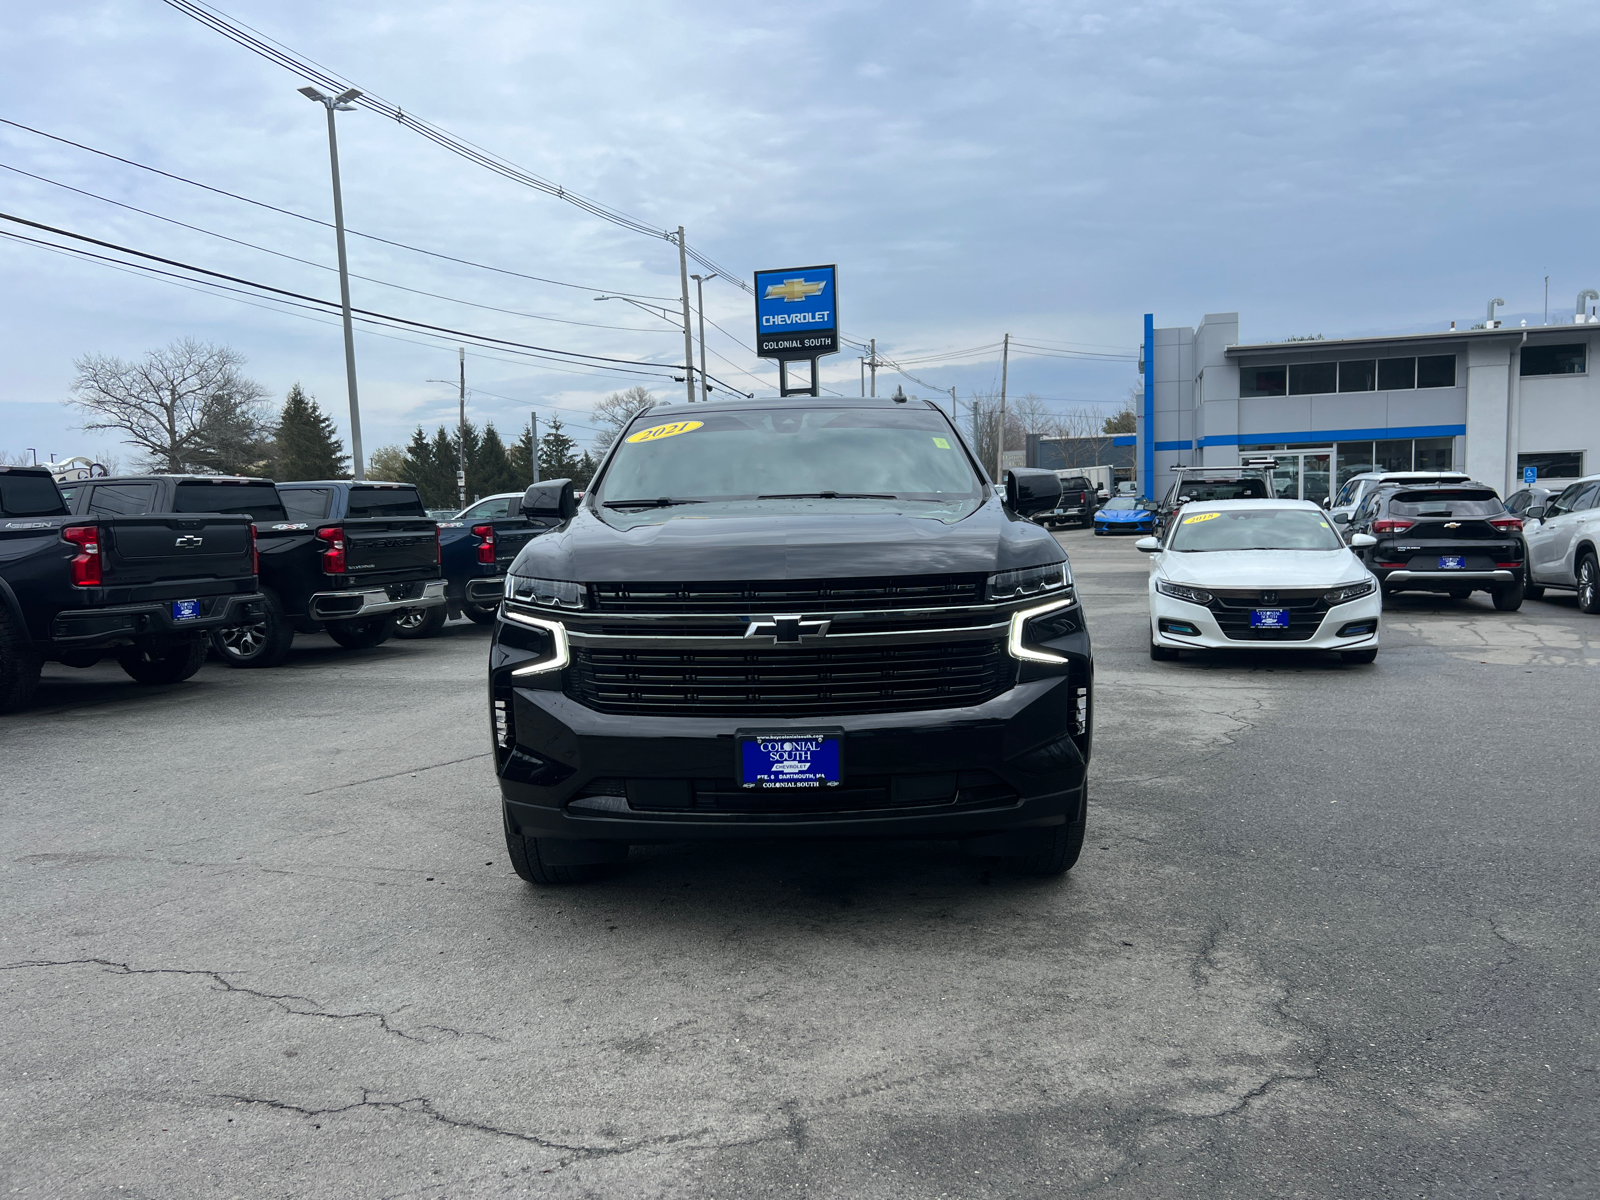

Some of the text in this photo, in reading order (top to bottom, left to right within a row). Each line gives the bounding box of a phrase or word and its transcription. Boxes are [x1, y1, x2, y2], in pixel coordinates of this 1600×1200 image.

[762, 311, 830, 326] CHEVROLET
[763, 338, 831, 350] COLONIAL SOUTH
[638, 421, 690, 441] 2021
[1190, 513, 1214, 523] 2018
[760, 741, 821, 752] COLONIAL
[769, 751, 811, 761] SOUTH
